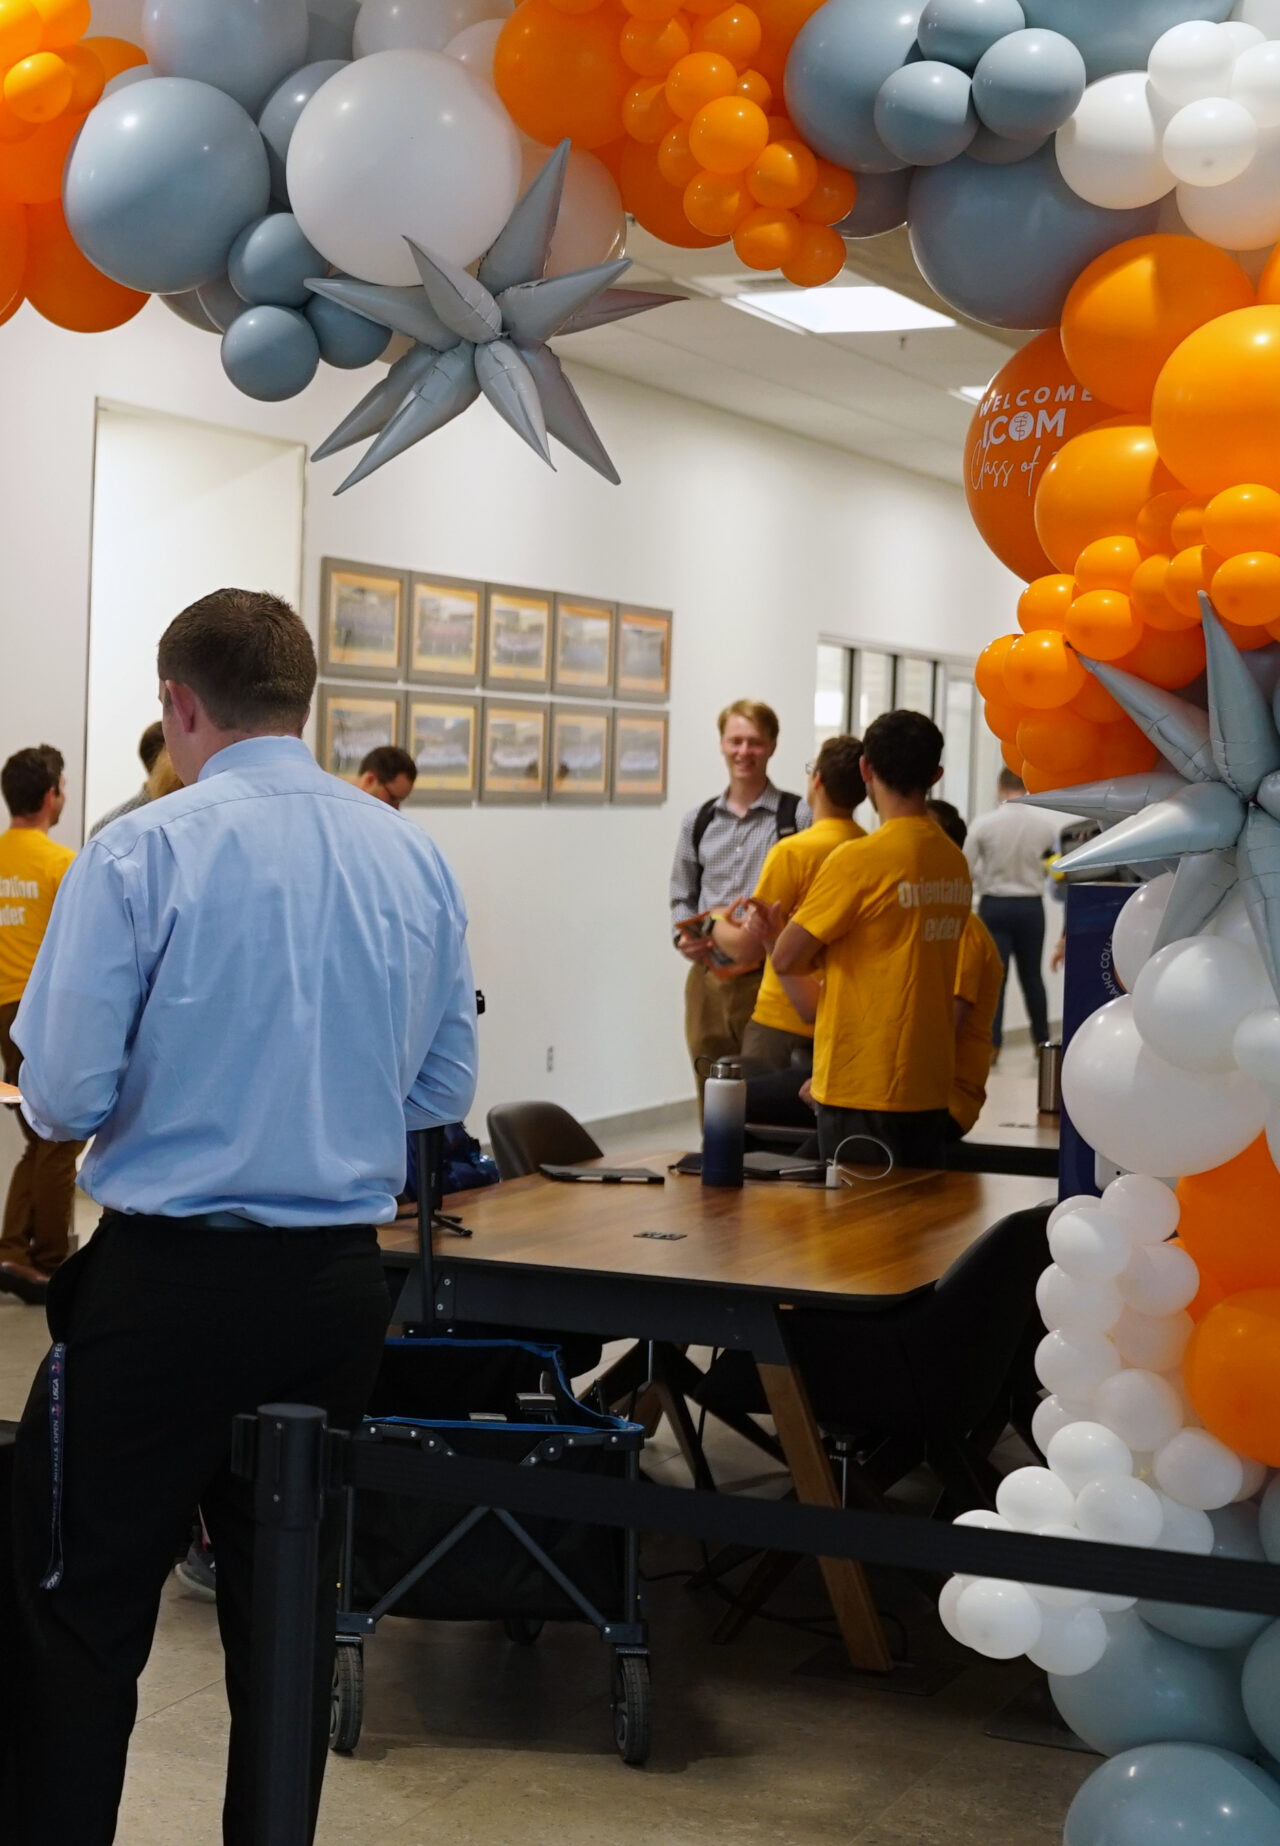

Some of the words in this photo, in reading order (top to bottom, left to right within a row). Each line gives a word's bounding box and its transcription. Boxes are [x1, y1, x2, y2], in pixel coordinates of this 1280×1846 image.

[979, 385, 1093, 418] WELCOME
[982, 407, 1067, 448] ICOM
[971, 439, 1014, 491] Class
[1020, 445, 1041, 497] of
[897, 877, 972, 909] Orientatio
